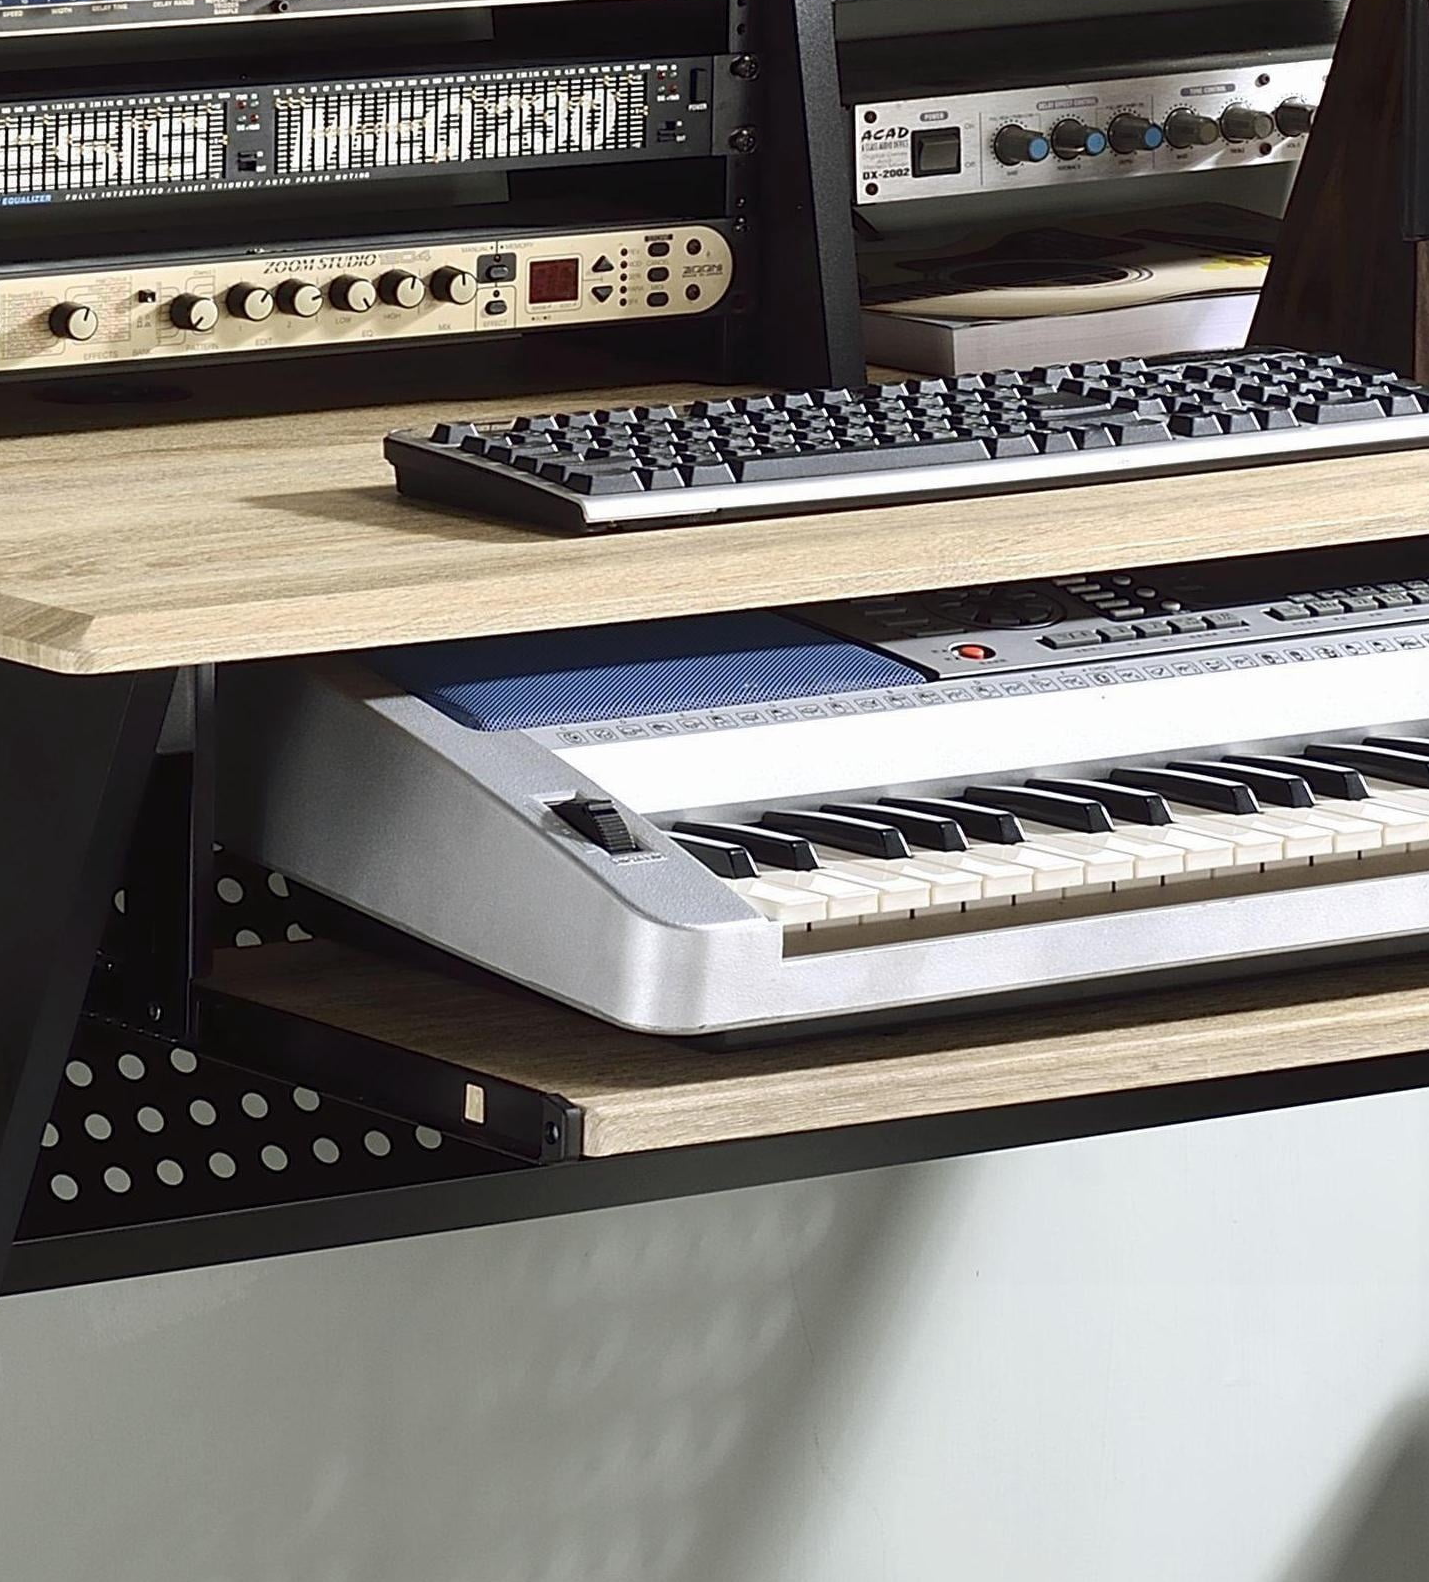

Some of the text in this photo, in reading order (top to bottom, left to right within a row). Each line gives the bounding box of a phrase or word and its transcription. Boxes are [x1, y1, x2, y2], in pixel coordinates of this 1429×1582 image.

[2, 10, 24, 18] SPEED
[861, 127, 909, 142] ACAD
[862, 168, 910, 180] DX-2002
[2, 194, 52, 206] EQUALIZER
[65, 191, 96, 201] FULLY
[263, 260, 315, 274] ZOOM
[316, 254, 377, 270] STUDIO
[682, 264, 723, 274] ZOOM
[438, 323, 451, 331] MIX
[83, 350, 119, 361] EFFECTS
